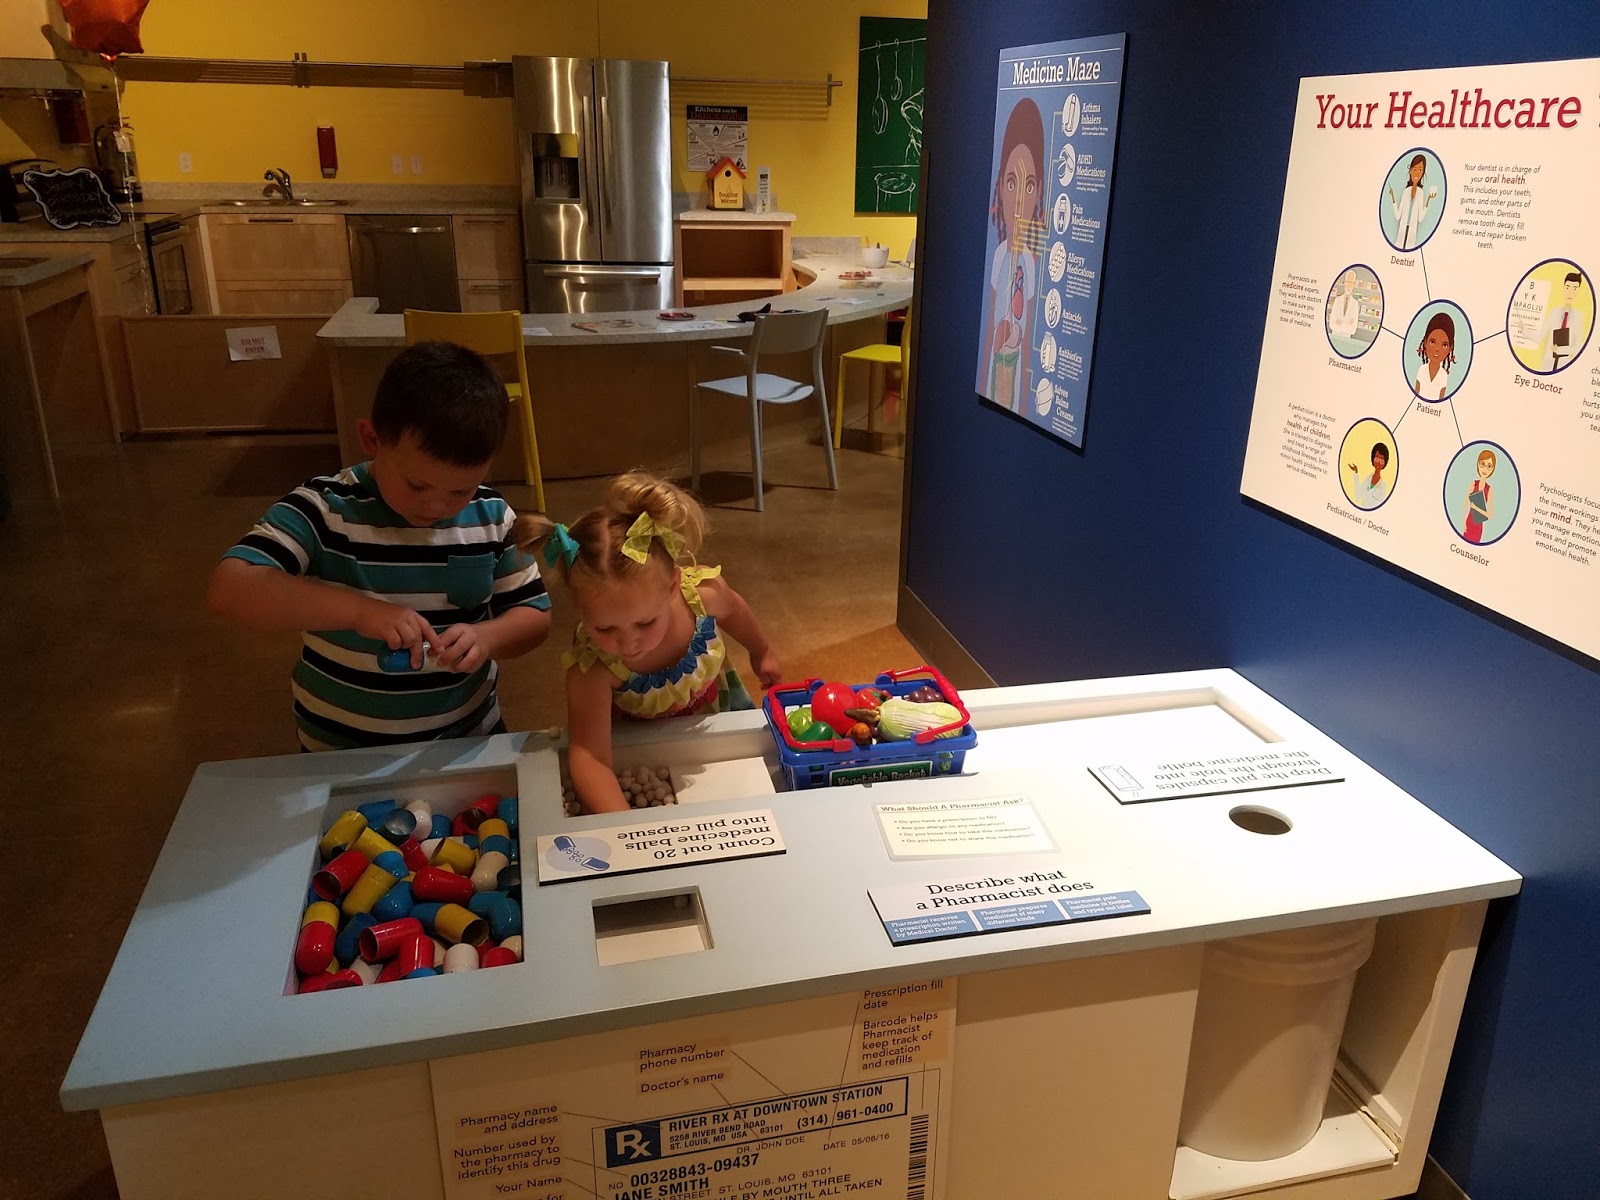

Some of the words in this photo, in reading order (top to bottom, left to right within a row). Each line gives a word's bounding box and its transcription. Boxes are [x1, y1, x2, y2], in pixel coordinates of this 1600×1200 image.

[1013, 59, 1064, 85] Medicine
[1066, 57, 1100, 82] Maze
[1315, 94, 1378, 129] Your
[1384, 88, 1581, 129] Healthcare
[1081, 115, 1101, 125] Inhalers
[1077, 154, 1093, 164] ADHD
[1076, 166, 1106, 177] Medications
[1464, 163, 1476, 171] Your
[1478, 164, 1497, 172] dentist
[1511, 165, 1532, 175] charge
[1470, 176, 1483, 184] your
[1485, 174, 1500, 183] oral
[1463, 185, 1474, 193] This
[1475, 186, 1498, 194] includes
[1499, 189, 1513, 197] your
[1072, 204, 1083, 214] Pain
[1071, 215, 1100, 229] Medications
[1067, 253, 1085, 266] Allergy
[1390, 255, 1415, 267] Dentist
[1066, 263, 1095, 279] Medications
[1062, 309, 1082, 323] Antacids
[1058, 347, 1082, 363] Antibiotics
[1328, 358, 1362, 373] Pharmacist
[1514, 374, 1531, 388] Eye
[1532, 378, 1564, 395] Doctor
[1056, 407, 1074, 422] Creams
[1416, 402, 1442, 417] Patient
[1540, 482, 1583, 503] Psychologists
[1539, 495, 1550, 505] the
[1550, 499, 1567, 510] inner
[1569, 507, 1599, 523] workings
[1326, 502, 1362, 526] Pediatrician
[1367, 519, 1390, 537] Doctor
[1531, 517, 1544, 526] you
[1545, 521, 1571, 535] manage
[1533, 507, 1549, 516] your
[1549, 511, 1572, 525] mind.
[1575, 519, 1592, 533] They
[1535, 529, 1553, 540] stress
[1554, 536, 1567, 545] and
[1567, 541, 1597, 556] promote
[1450, 543, 1490, 567] Counselor
[1535, 540, 1568, 557] emotional
[1568, 551, 1591, 566] health.
[1207, 754, 1280, 765] medicine
[1284, 751, 1310, 759] the
[1158, 761, 1202, 771] bottle
[1191, 768, 1227, 777] hole
[1228, 765, 1256, 773] the
[1256, 759, 1321, 771] through
[1290, 767, 1332, 776] Drop
[1154, 771, 1185, 780] into
[1232, 774, 1258, 784] pill
[1263, 771, 1289, 780] the
[1156, 778, 1228, 790] capsules
[950, 801, 1001, 809] Pharmacist
[696, 819, 726, 831] pill
[732, 815, 767, 825] into
[617, 825, 690, 840] capsule
[678, 826, 770, 843] medecine
[625, 838, 672, 850] balls
[682, 844, 712, 856] out
[719, 837, 775, 851] Count
[654, 849, 676, 860] 20
[925, 877, 1015, 895] Describe
[1018, 870, 1067, 883] what
[916, 902, 929, 910] a
[930, 887, 1044, 908] Pharmacist
[1048, 882, 1095, 894] does
[864, 983, 927, 999] Prescription
[930, 979, 943, 989] fill
[863, 1000, 888, 1010] date
[863, 1016, 907, 1030] Barcode
[910, 1012, 938, 1023] helps
[862, 1040, 889, 1050] keep
[892, 1034, 918, 1045] track
[921, 1030, 933, 1041] of
[863, 1024, 921, 1040] Pharmacist
[640, 1043, 697, 1060] Pharmacy
[862, 1045, 921, 1060] medication
[640, 1058, 677, 1073] phone
[680, 1049, 725, 1063] number
[862, 1059, 882, 1070] and
[884, 1054, 913, 1066] refills
[641, 1077, 690, 1093] Doctor's
[693, 1072, 724, 1084] name
[460, 1111, 520, 1127] Pharmacy
[524, 1105, 557, 1117] name
[669, 1117, 708, 1132] RIVER
[712, 1111, 729, 1125] RX
[733, 1109, 749, 1121] AT
[753, 1095, 828, 1117] DOWNTOWN
[832, 1086, 883, 1103] STATION
[797, 1114, 828, 1130] (314)
[836, 1102, 894, 1121] 961-0400
[484, 1122, 507, 1134] and
[511, 1115, 559, 1130] address
[669, 1134, 690, 1143] 5258
[692, 1129, 717, 1139] RIVER
[719, 1125, 741, 1135] BEND
[743, 1120, 766, 1130] ROAD
[616, 1129, 652, 1160] Rx
[669, 1142, 682, 1151] ST.
[684, 1138, 711, 1148] LOUIS,
[713, 1134, 726, 1144] MO
[731, 1131, 748, 1140] USA
[760, 1124, 783, 1135] 63101
[736, 1146, 752, 1154] DR.
[755, 1140, 783, 1151] JOHN
[785, 1136, 805, 1145] DOE
[454, 1144, 505, 1159] Number
[508, 1136, 537, 1150] used
[541, 1135, 556, 1145] by
[823, 1141, 847, 1151] DATE
[460, 1159, 481, 1169] the
[485, 1148, 544, 1167] pharmacy
[547, 1146, 560, 1154] to
[458, 1165, 504, 1180] identify
[507, 1161, 529, 1172] this
[532, 1156, 561, 1167] drug
[608, 1182, 624, 1191] NO
[630, 1153, 760, 1188] 00328843-09437
[496, 1183, 523, 1194] Your
[527, 1176, 562, 1188] Name
[658, 1177, 709, 1197] SMITH
[673, 1189, 712, 1200] STREET
[718, 1186, 735, 1194] ST.
[778, 1173, 796, 1183] MO
[802, 1167, 832, 1179] 63101
[763, 1183, 808, 1197] MOUTH
[812, 1174, 852, 1187] THREE
[819, 1185, 841, 1195] ALL
[844, 1178, 883, 1192] TAKEN
